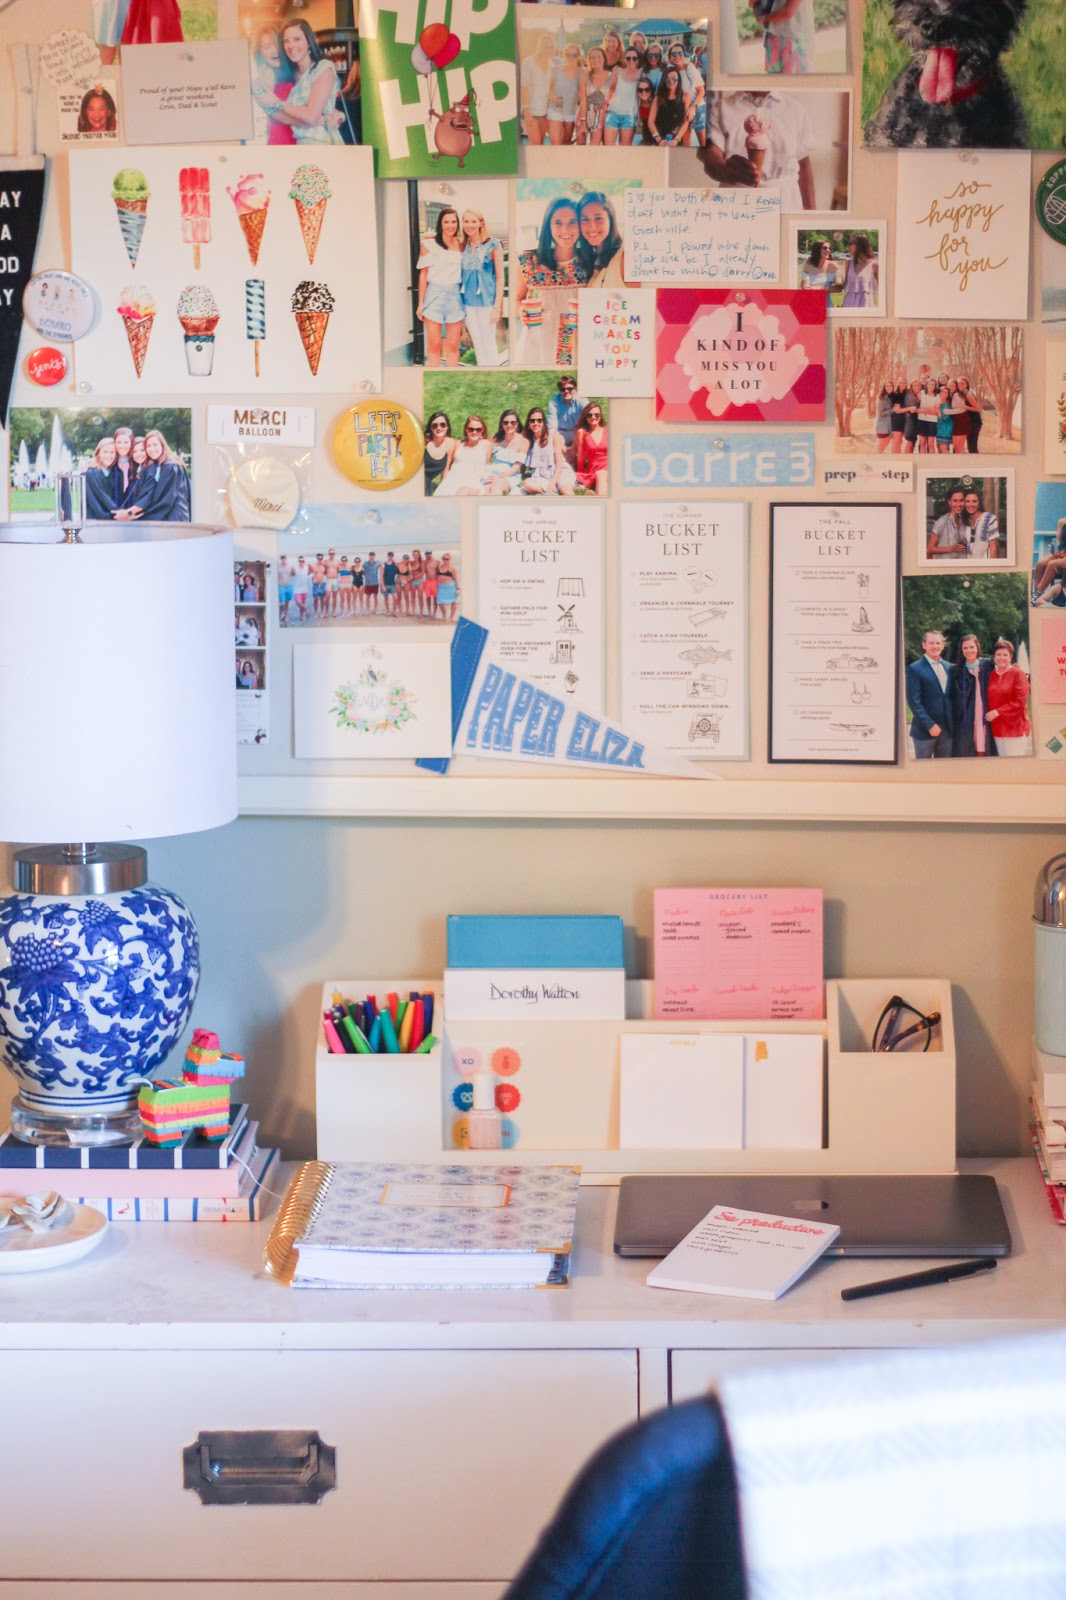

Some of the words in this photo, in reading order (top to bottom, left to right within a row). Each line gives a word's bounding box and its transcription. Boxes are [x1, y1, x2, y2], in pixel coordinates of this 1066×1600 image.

[139, 87, 159, 95] Proud
[161, 87, 168, 95] of
[166, 95, 184, 103] great
[1046, 163, 1066, 189] KAPP
[944, 180, 992, 199] so
[717, 209, 728, 218] to
[916, 200, 1004, 232] happy
[1, 224, 13, 241] A
[924, 233, 969, 272] for
[949, 257, 1009, 292] you
[0, 288, 14, 306] Y
[606, 300, 628, 311] ICE
[593, 314, 641, 325] CREAM
[735, 311, 744, 333] I
[593, 328, 641, 341] MAKES
[603, 343, 631, 355] YOU
[696, 339, 748, 351] KIND
[754, 339, 780, 351] OF
[595, 358, 638, 369] HAPPY
[701, 361, 746, 372] MISS
[747, 361, 778, 372] YOU
[714, 379, 723, 390] A
[730, 379, 762, 390] LOT
[233, 410, 287, 425] MERCI
[238, 427, 282, 437] BALLOON
[824, 469, 857, 483] prep
[881, 469, 910, 483] step
[503, 530, 577, 543] BUCKET
[645, 524, 720, 537] BUCKET
[804, 530, 866, 540] BUCKET
[520, 549, 561, 563] LIST
[662, 543, 702, 556] LIST
[818, 545, 853, 556] LIST
[466, 663, 566, 758] PAPER
[566, 711, 645, 768] ELIZA
[489, 982, 539, 1005] Dorothy
